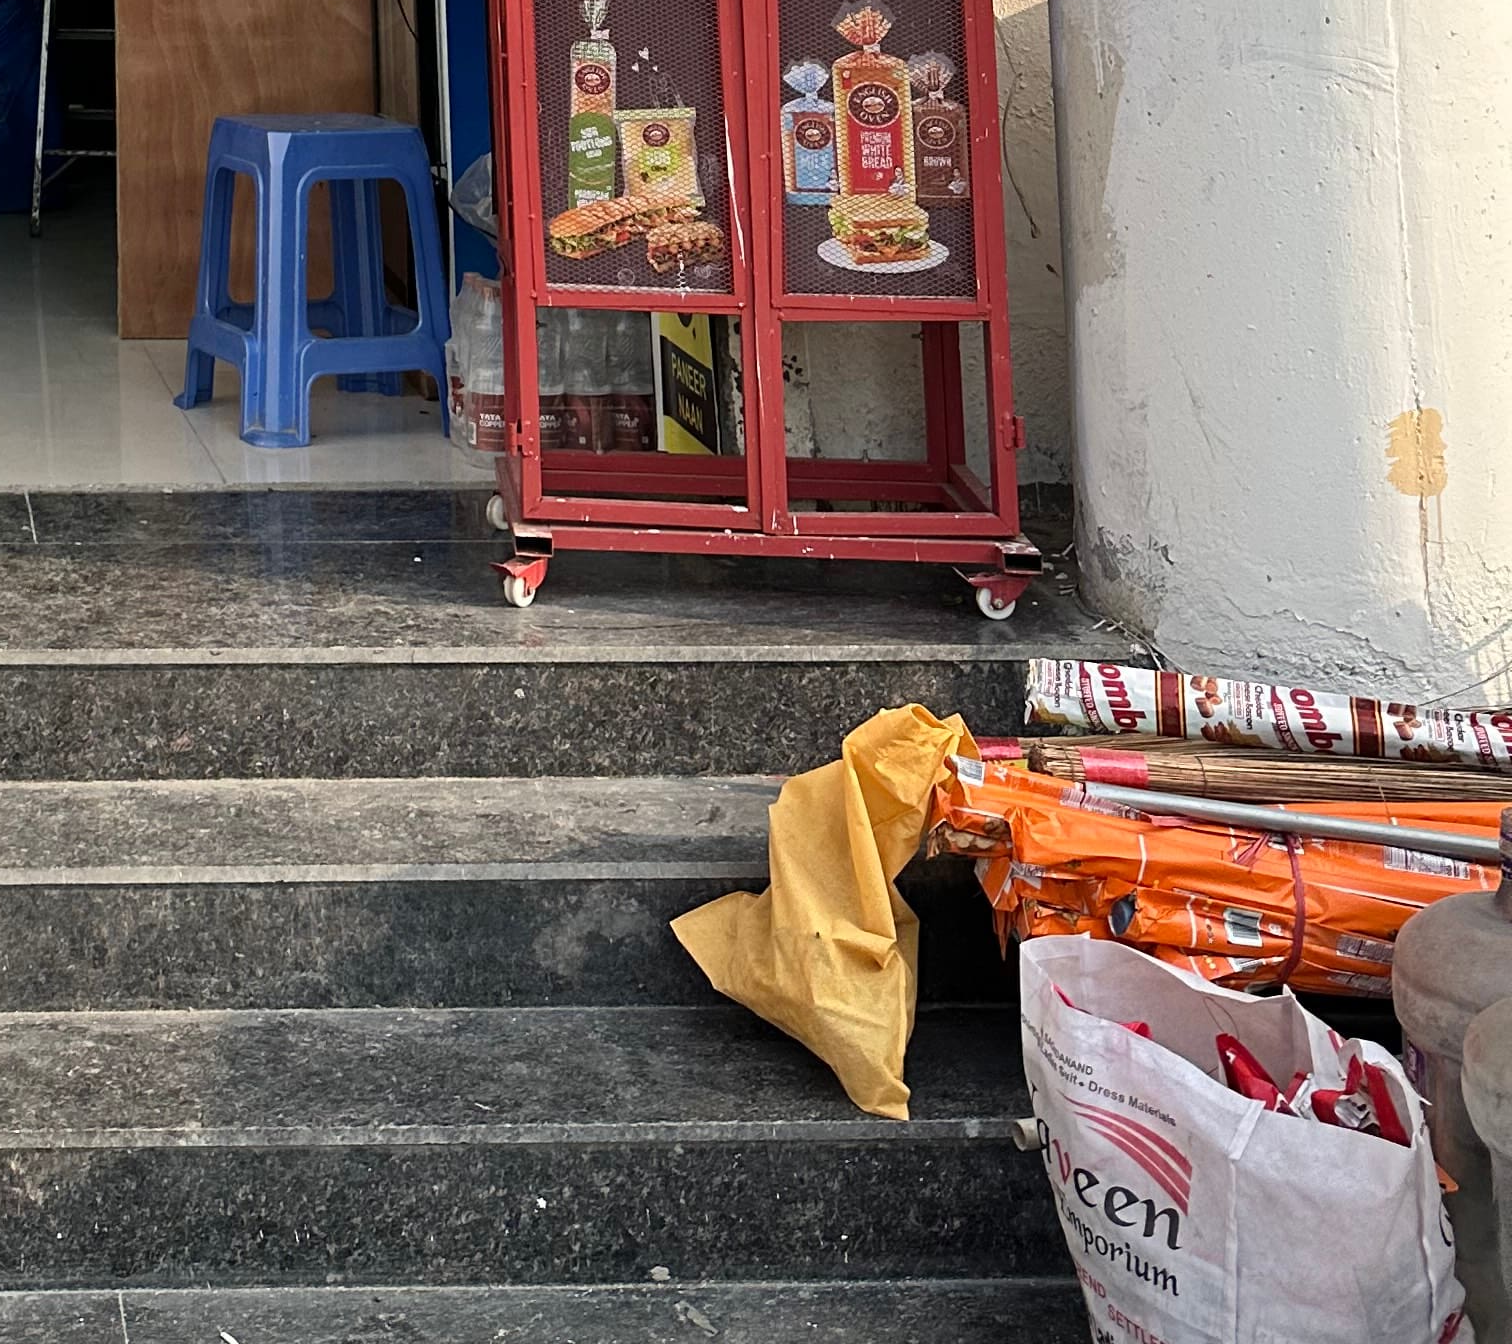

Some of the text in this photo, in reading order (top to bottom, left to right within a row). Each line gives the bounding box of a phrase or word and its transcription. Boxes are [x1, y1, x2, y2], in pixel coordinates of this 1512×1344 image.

[861, 144, 892, 157] WHITE
[861, 157, 893, 169] BREAD
[671, 351, 707, 401] PANEER
[479, 413, 502, 421] TATA
[479, 420, 504, 429] COPPE
[678, 392, 704, 435] NAAN
[1058, 1064, 1078, 1086] Suit
[1087, 1080, 1125, 1104] Dress
[1128, 1095, 1177, 1127] Materials
[1075, 1262, 1107, 1299] REND
